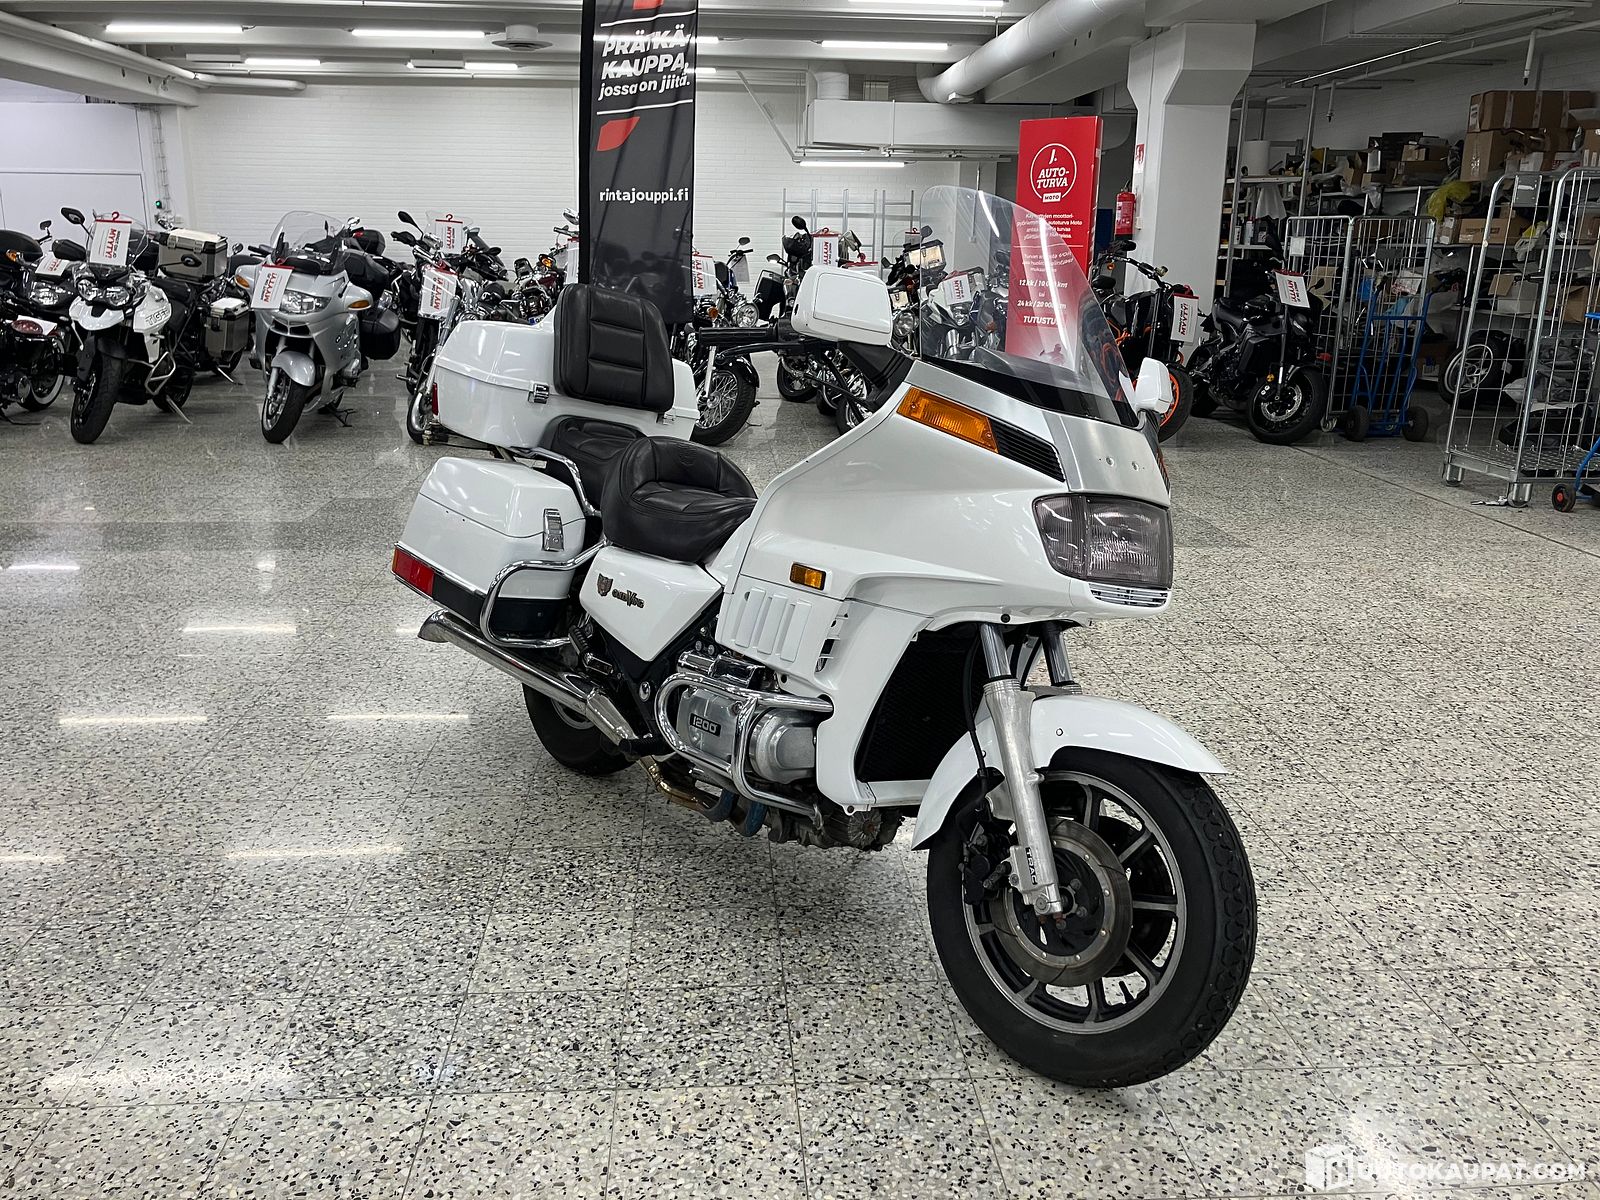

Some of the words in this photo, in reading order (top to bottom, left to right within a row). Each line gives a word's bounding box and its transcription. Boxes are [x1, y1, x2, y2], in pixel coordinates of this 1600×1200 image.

[598, 83, 638, 101] jossa
[639, 80, 658, 92] on
[659, 72, 690, 94] jiitä.
[1038, 167, 1070, 179] AUTO-
[1036, 178, 1069, 189] TURVA
[600, 188, 689, 204] rintajouppi.fi
[692, 715, 717, 734] 1200
[1025, 848, 1037, 885] TRAC
